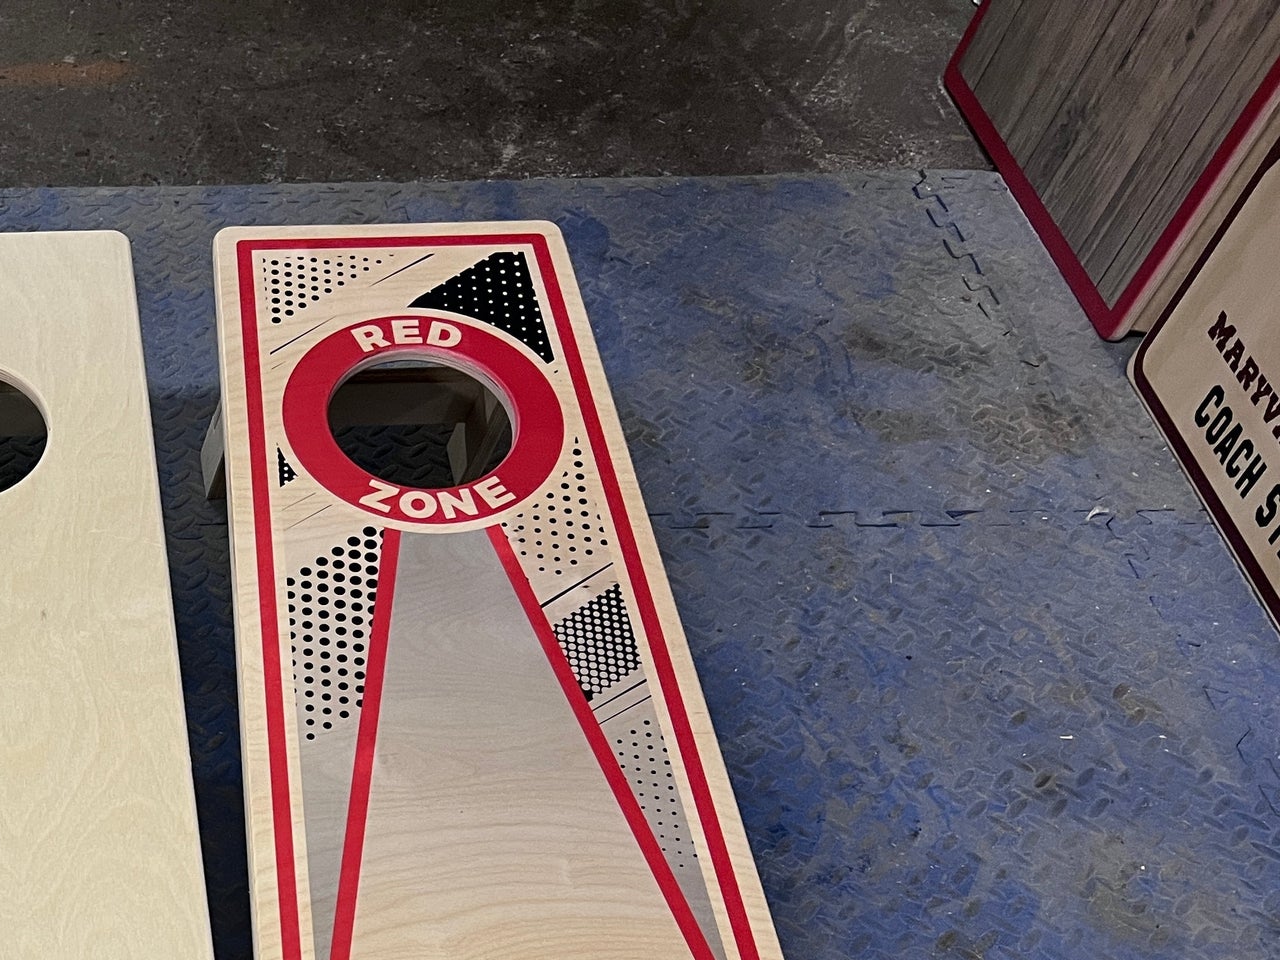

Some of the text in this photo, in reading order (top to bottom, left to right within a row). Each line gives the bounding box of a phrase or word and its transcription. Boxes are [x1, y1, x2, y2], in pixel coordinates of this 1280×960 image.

[350, 319, 462, 352] RED
[1207, 310, 1280, 440] MARYV
[1195, 385, 1267, 499] COACH
[358, 475, 517, 519] ZONE
